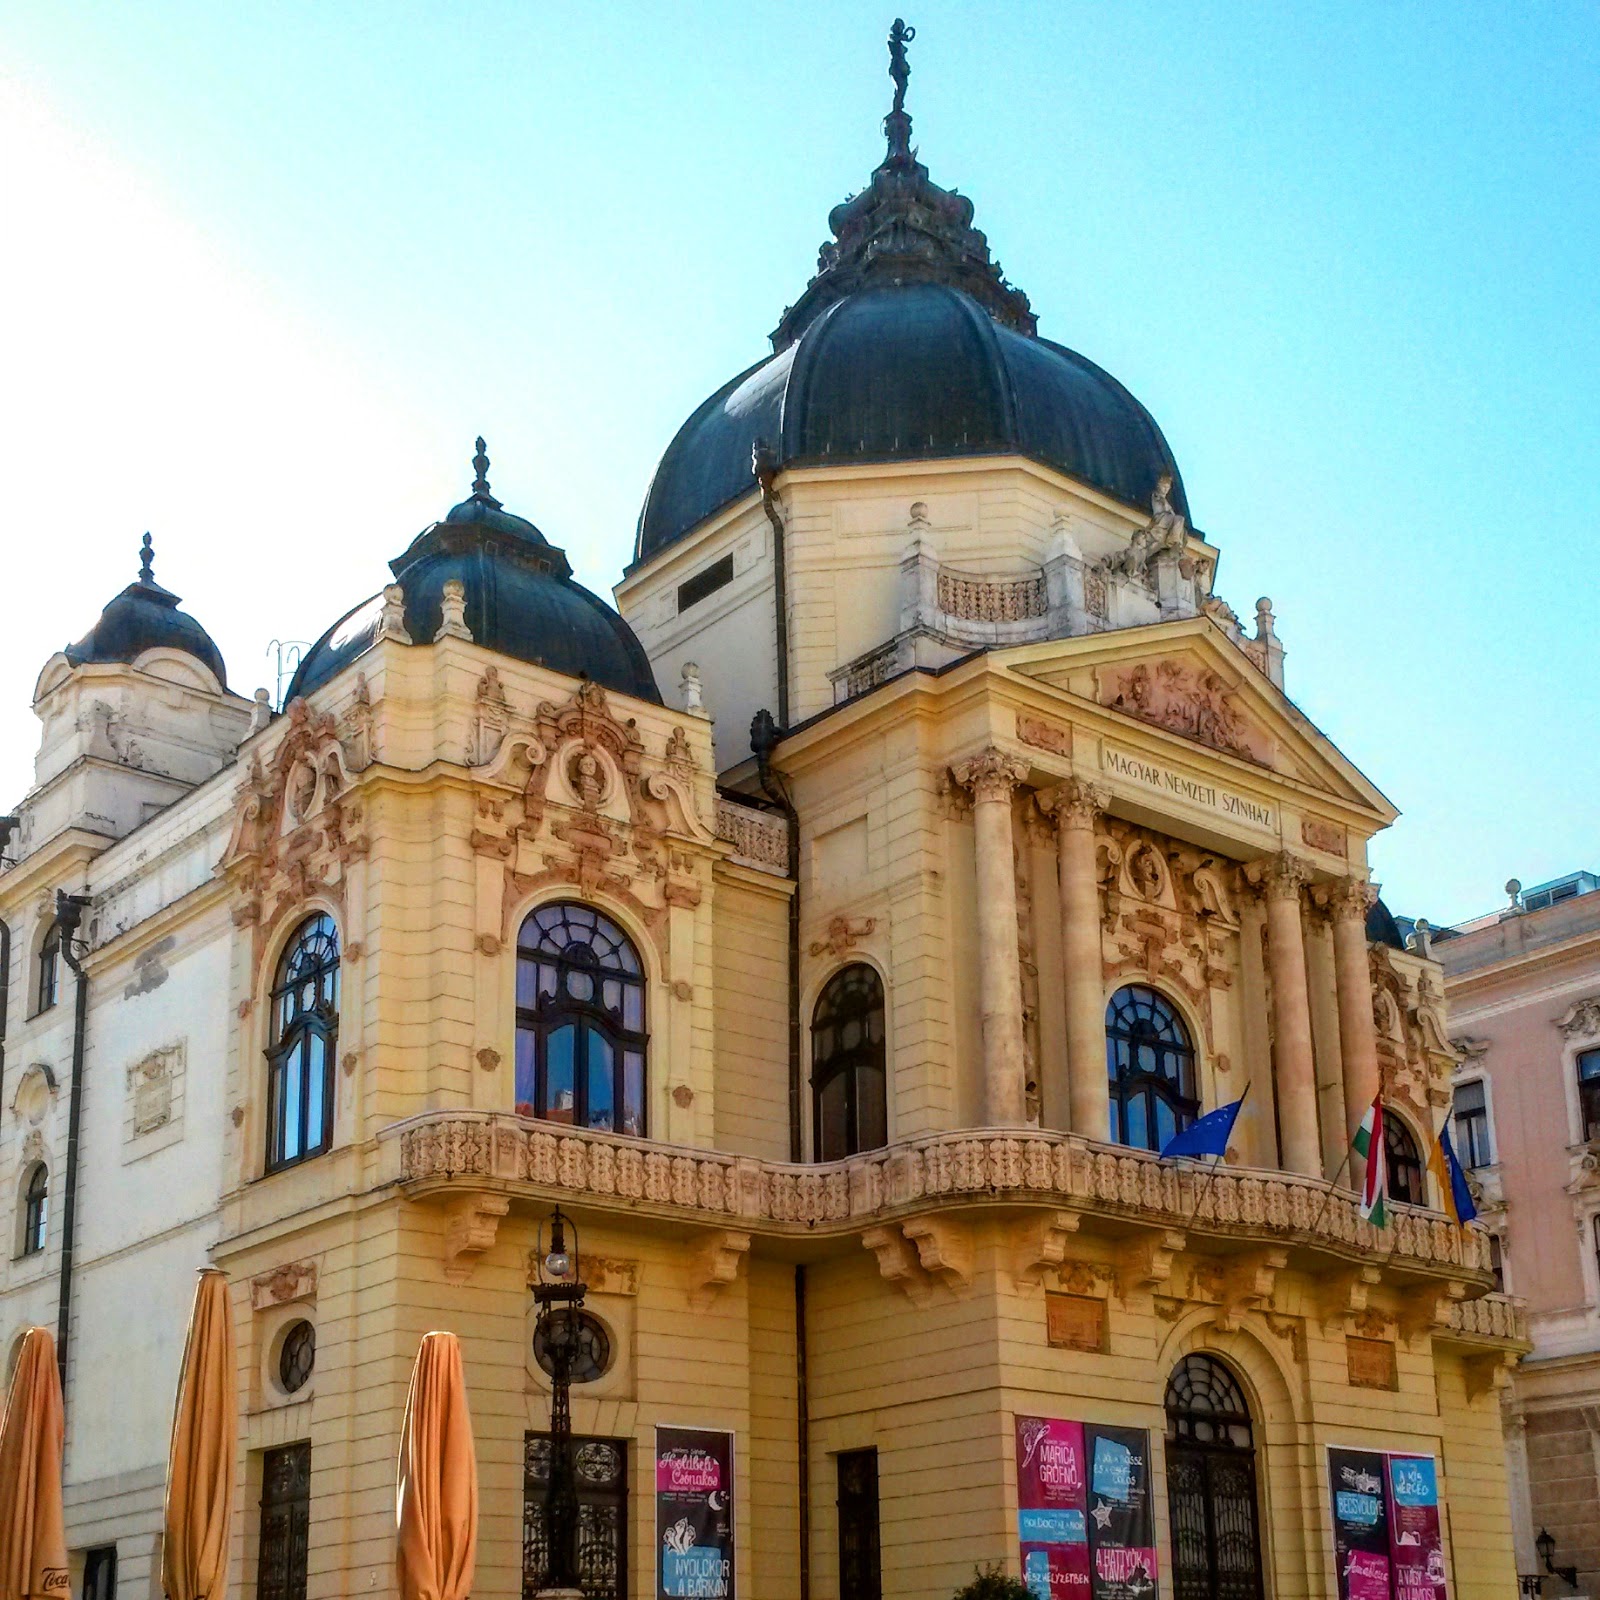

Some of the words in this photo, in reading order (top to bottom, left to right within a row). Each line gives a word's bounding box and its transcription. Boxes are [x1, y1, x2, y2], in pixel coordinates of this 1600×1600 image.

[1106, 750, 1162, 787] MAGYAR
[1164, 771, 1216, 807] NEMZETI
[1040, 1444, 1075, 1466] MARICA
[1095, 1548, 1102, 1566] A
[675, 1558, 730, 1578] NYOLCKOR
[1022, 1567, 1089, 1585] VÉSZHELYZETBEN
[677, 1578, 685, 1597] A
